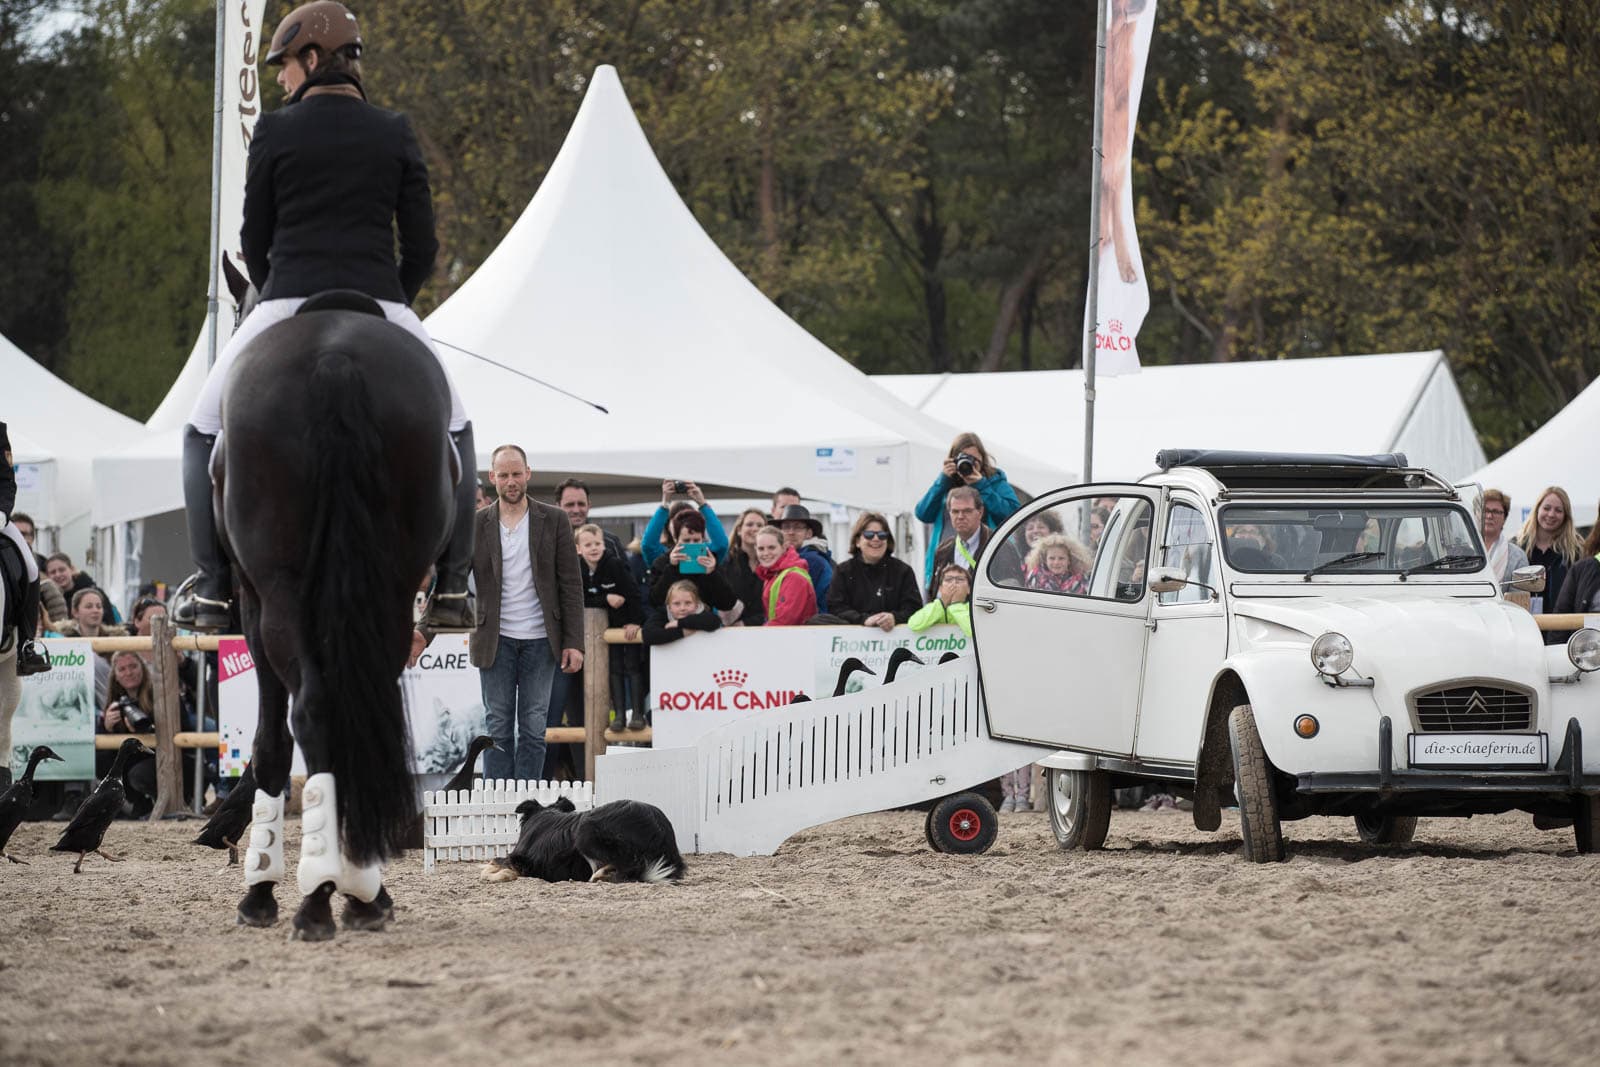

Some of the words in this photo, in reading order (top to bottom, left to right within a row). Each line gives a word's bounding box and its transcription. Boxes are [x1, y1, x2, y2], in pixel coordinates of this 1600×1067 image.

[915, 634, 967, 651] Combo
[43, 650, 86, 667] ombo
[222, 650, 255, 677] Nie
[419, 653, 468, 670] CARE
[659, 691, 728, 711] ROYAL
[1424, 741, 1536, 757] die-schaeferin.de
